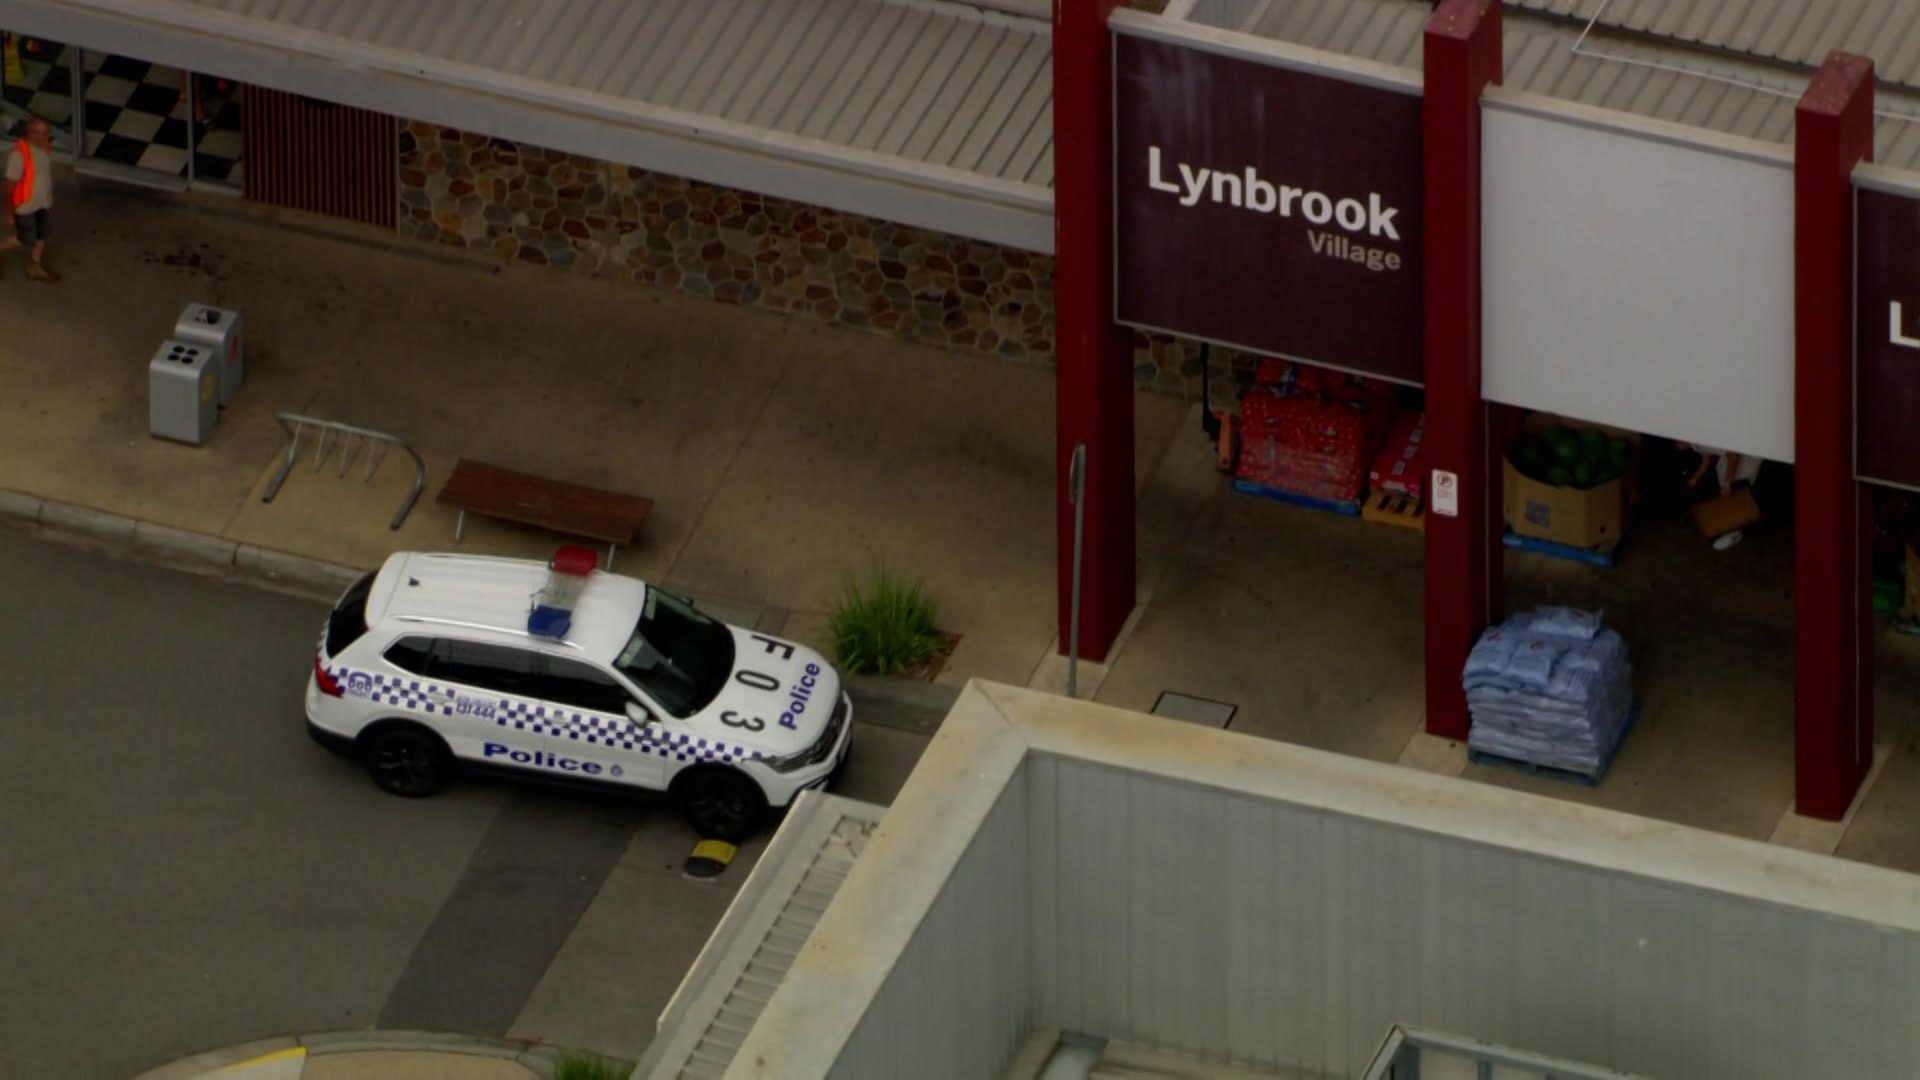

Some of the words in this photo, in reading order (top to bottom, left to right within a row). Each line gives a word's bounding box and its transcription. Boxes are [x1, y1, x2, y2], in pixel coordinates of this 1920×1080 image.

[1149, 146, 1400, 240] Lynbrook
[1307, 228, 1401, 271] Village
[778, 663, 820, 730] Police
[484, 742, 603, 775] Police
